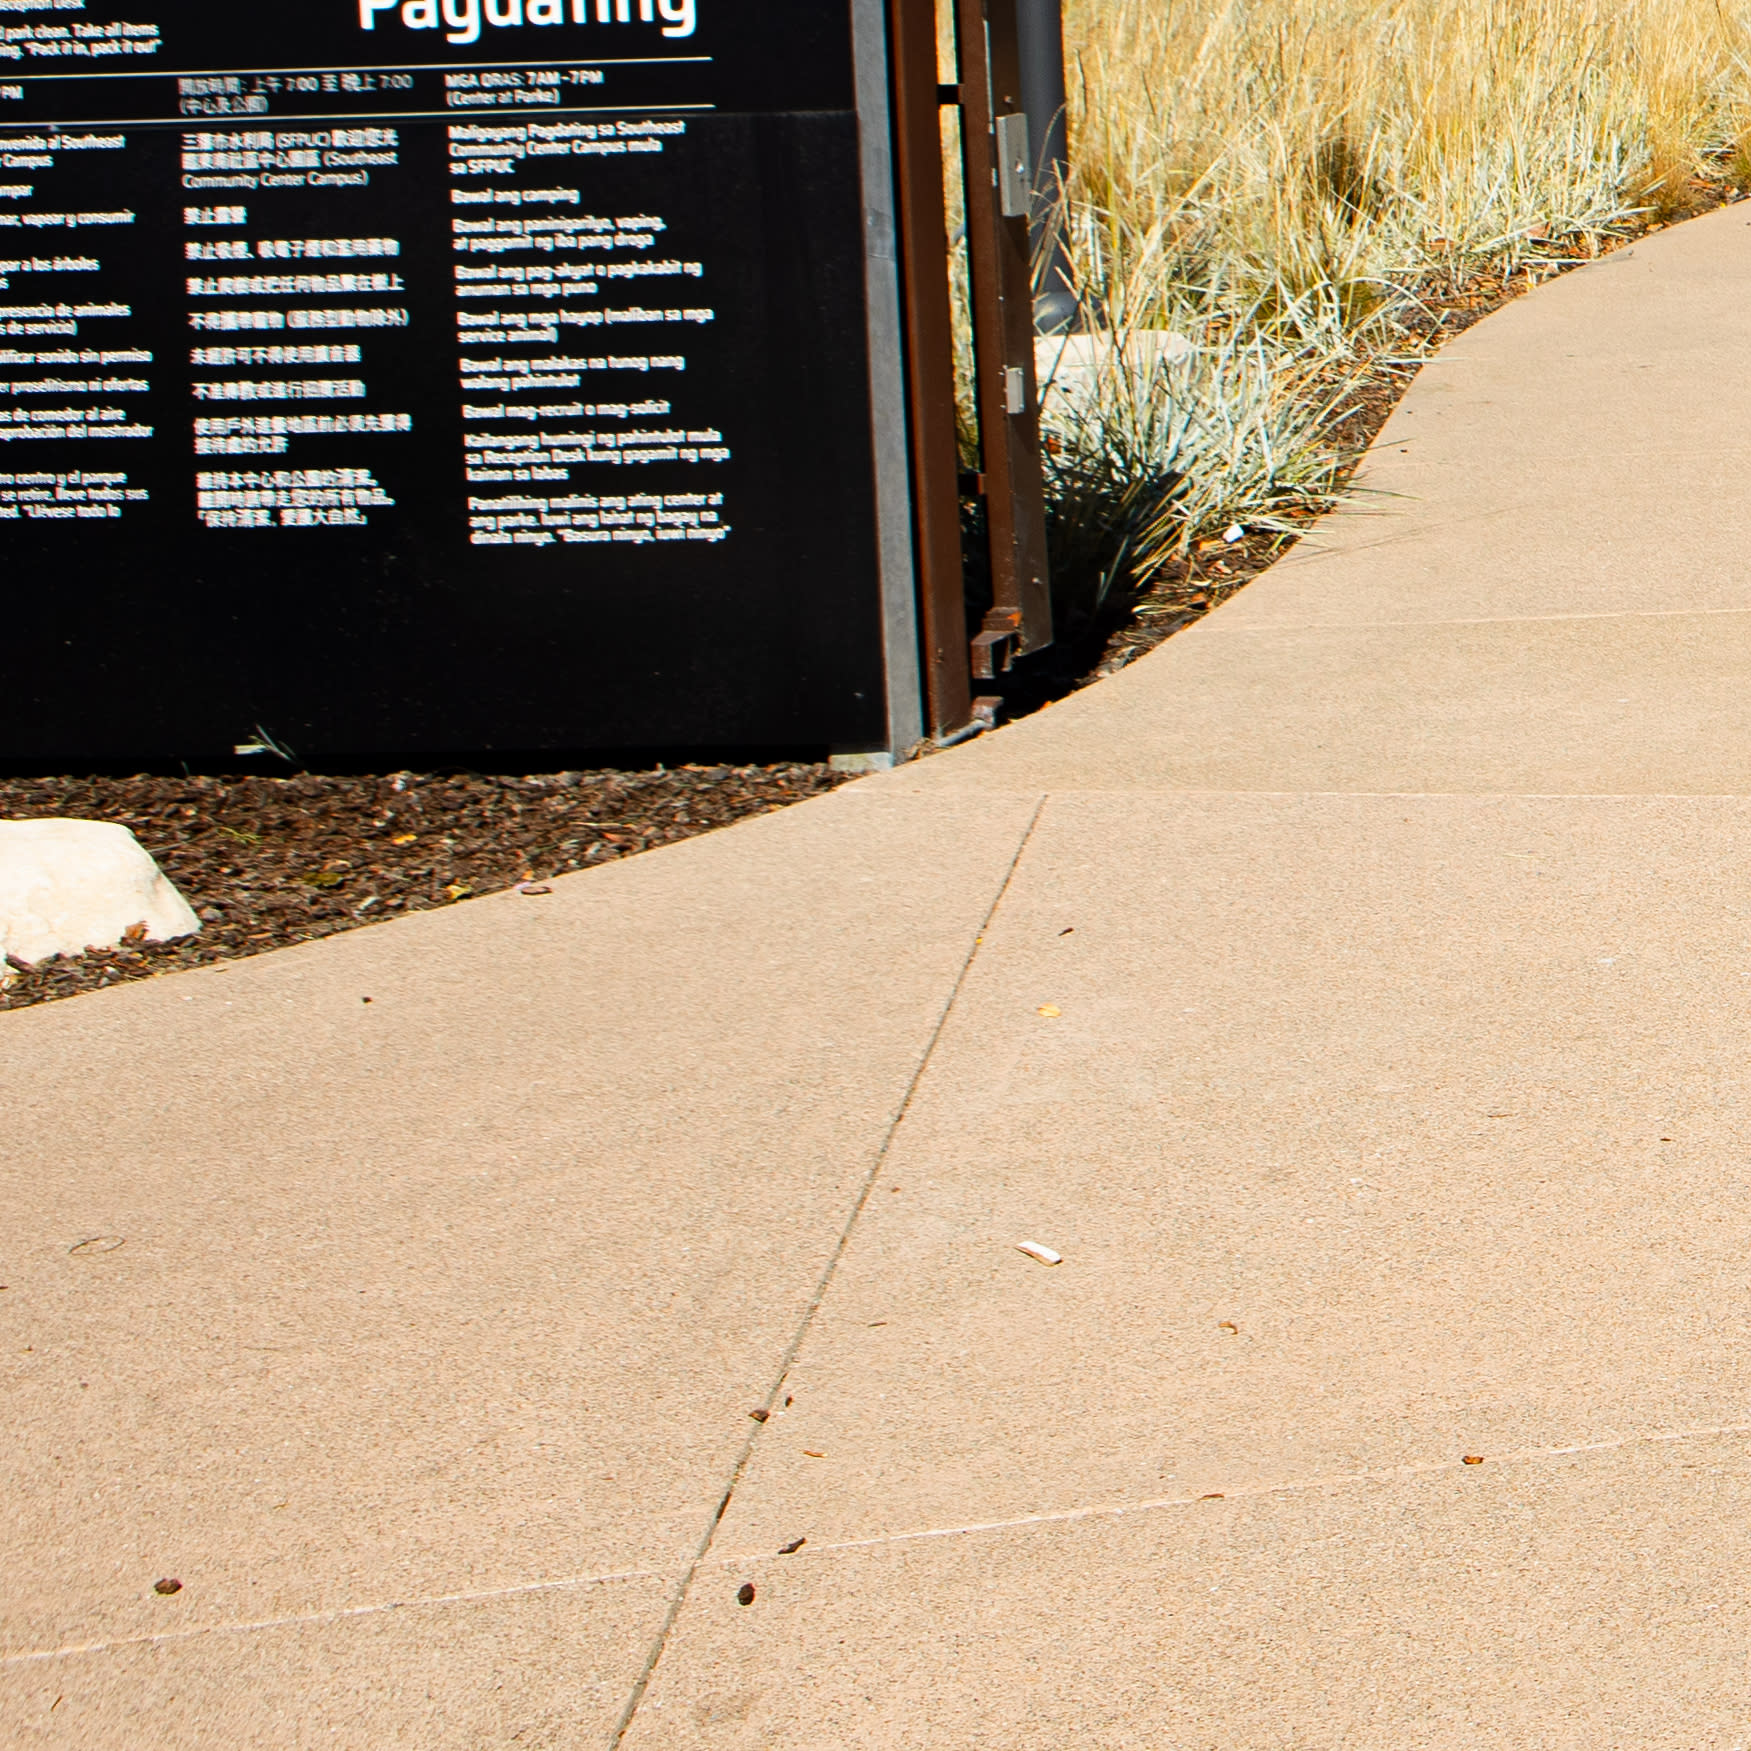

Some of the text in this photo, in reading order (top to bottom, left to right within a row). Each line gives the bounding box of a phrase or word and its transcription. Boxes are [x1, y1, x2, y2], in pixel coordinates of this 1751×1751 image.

[4, 24, 35, 42] park
[71, 23, 105, 37] Take
[121, 21, 160, 37] items
[90, 38, 122, 58] pack
[448, 120, 686, 142] Maligayang Pagdating sa Southeast
[61, 134, 127, 149] Southeast
[449, 137, 663, 159] Community Center Campus mula
[2, 153, 54, 169] Campus
[449, 162, 468, 174] sa
[494, 190, 521, 206] ang
[521, 186, 580, 205] camping
[495, 220, 523, 235] ang
[534, 235, 554, 251] ng
[577, 235, 614, 251] pang
[498, 266, 525, 281] ang
[512, 283, 530, 295] sa
[530, 283, 561, 298] mga
[500, 313, 528, 328] ang
[528, 312, 559, 327] mga
[664, 309, 682, 321] sa
[682, 308, 714, 324] mga
[457, 328, 507, 343] service
[100, 347, 153, 366] permiso
[502, 359, 530, 375] ang
[588, 357, 607, 369] na
[465, 453, 483, 464] sa
[483, 448, 551, 466] Reception
[551, 447, 586, 463] Desk
[699, 447, 731, 462] mga
[513, 468, 531, 481] sa
[599, 495, 627, 511] ang
[663, 492, 707, 507] center
[707, 492, 723, 506] at
[468, 515, 497, 531] ang
[571, 513, 599, 528] ang
[699, 511, 719, 523] na
